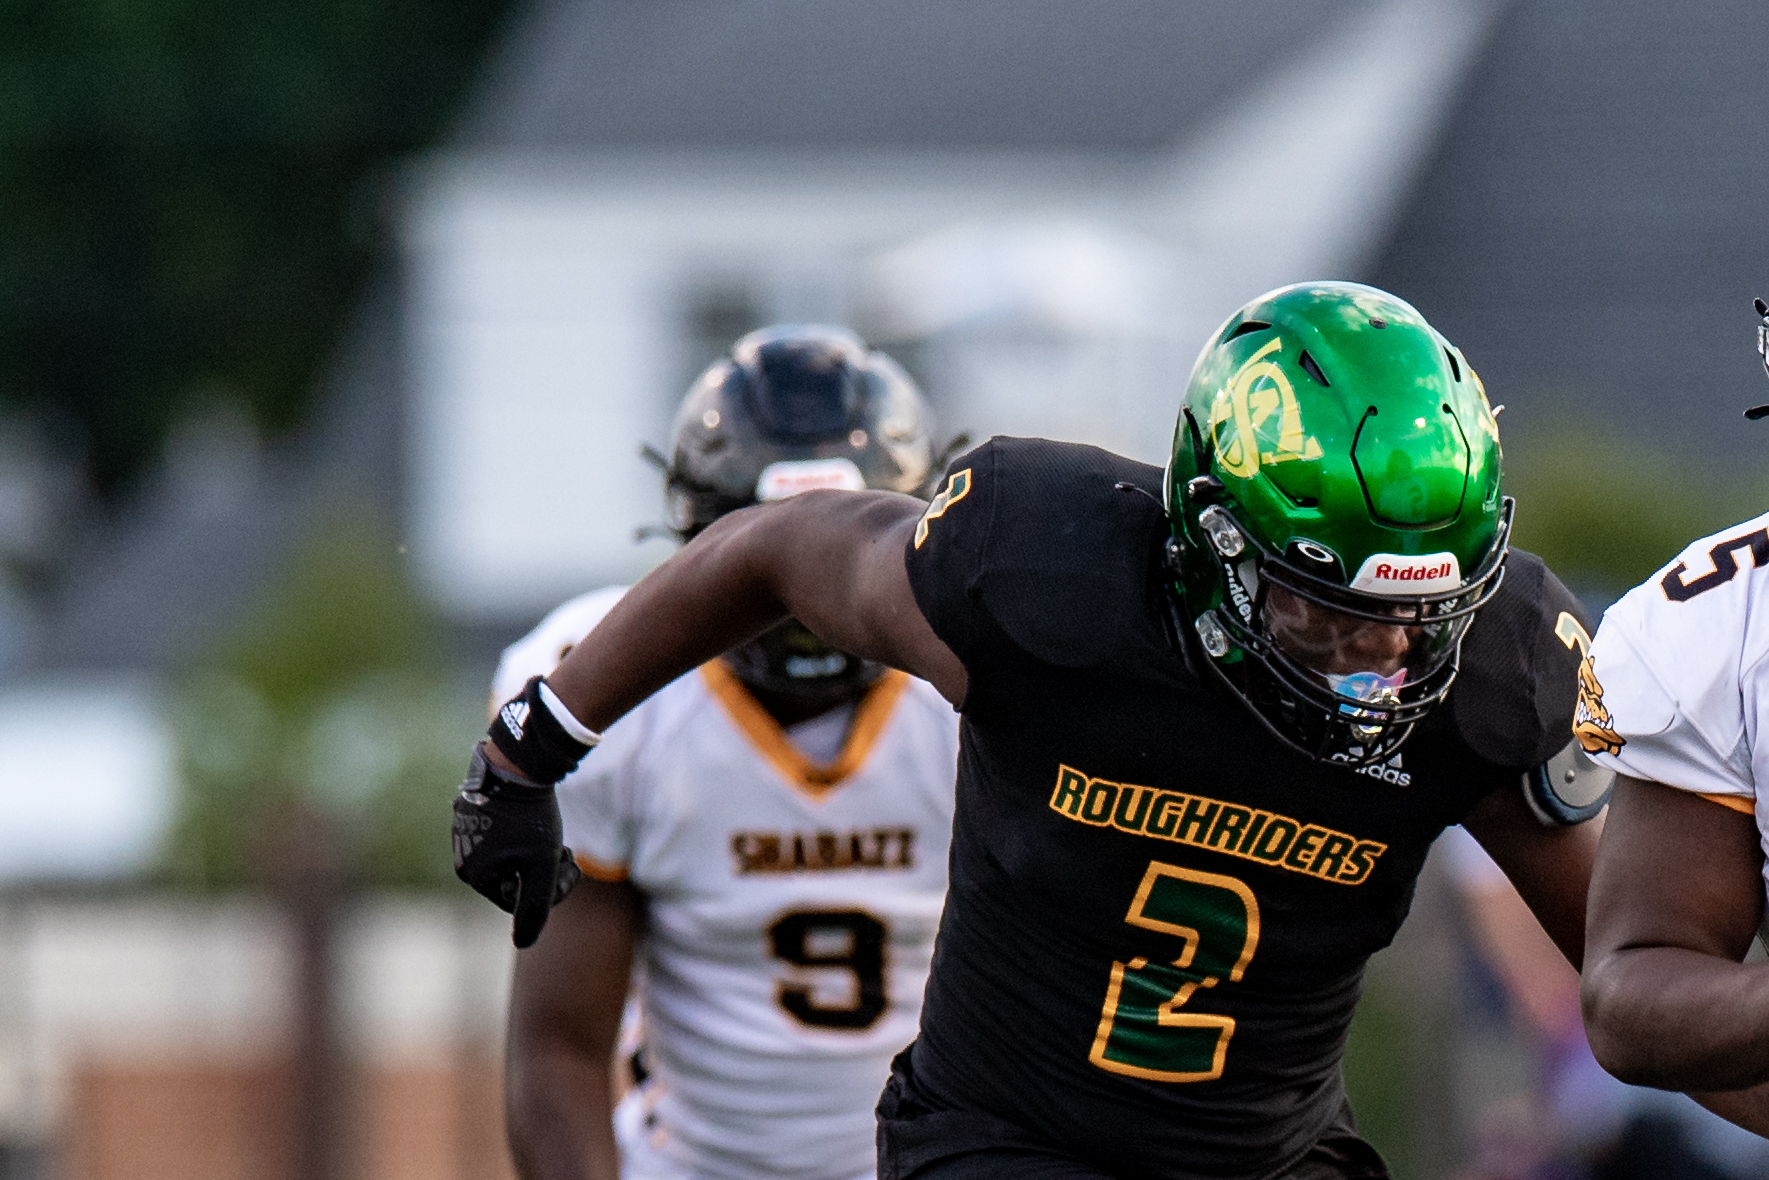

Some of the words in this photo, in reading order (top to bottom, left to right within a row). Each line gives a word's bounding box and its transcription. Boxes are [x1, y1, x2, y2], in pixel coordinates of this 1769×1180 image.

[1375, 562, 1452, 581] Riddell
[1049, 763, 1388, 886] ROUGHRIDERS
[766, 904, 889, 1031] 9
[1088, 860, 1261, 1083] 2
